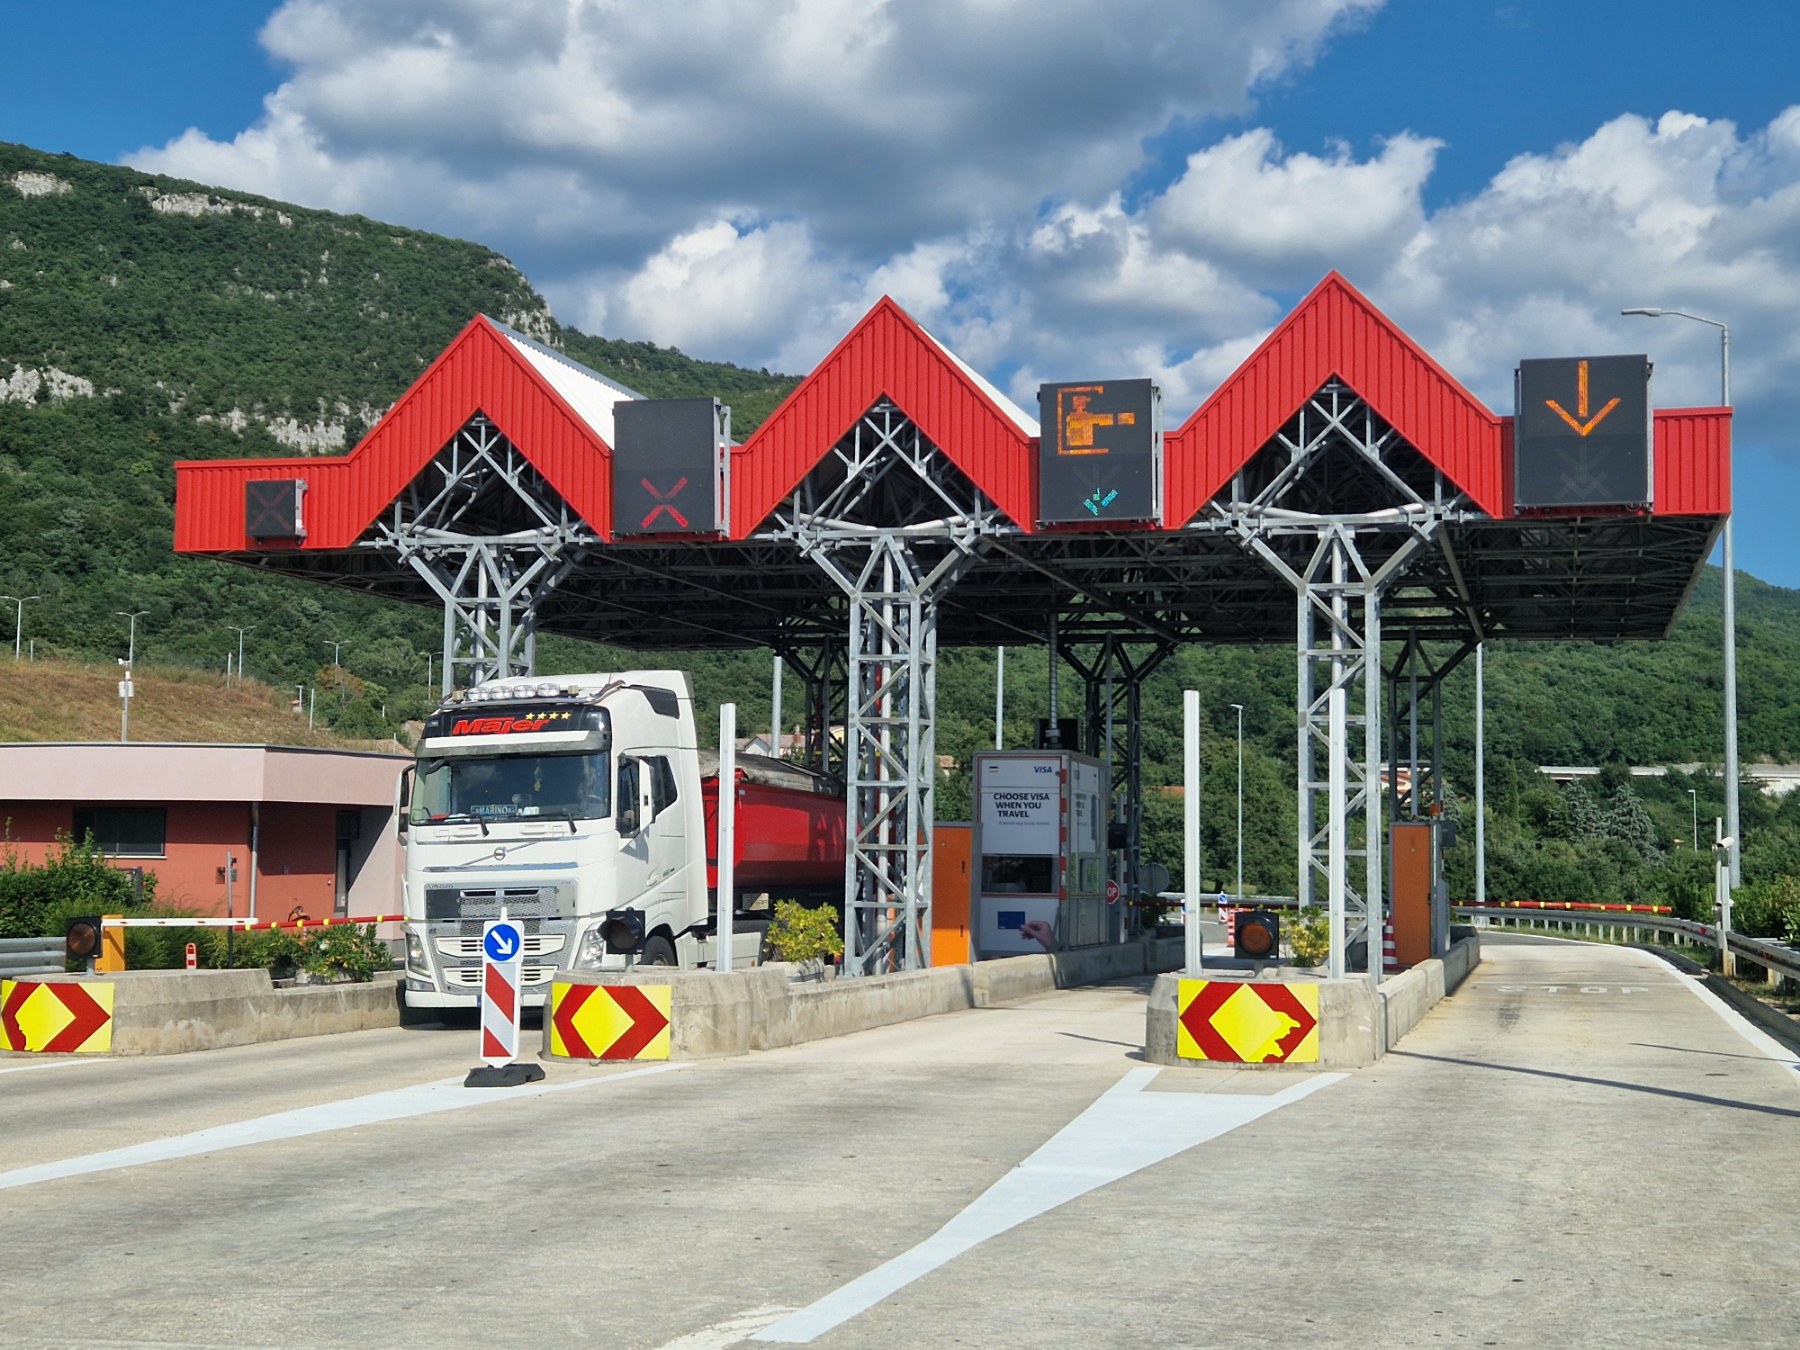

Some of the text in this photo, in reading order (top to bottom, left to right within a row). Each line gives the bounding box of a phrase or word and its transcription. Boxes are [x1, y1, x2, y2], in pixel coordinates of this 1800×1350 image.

[1034, 766, 1053, 774] VISA
[993, 793, 1050, 801] CHOOSE VISA
[997, 810, 1029, 818] TRAVEL
[1498, 985, 1649, 994] STOP
